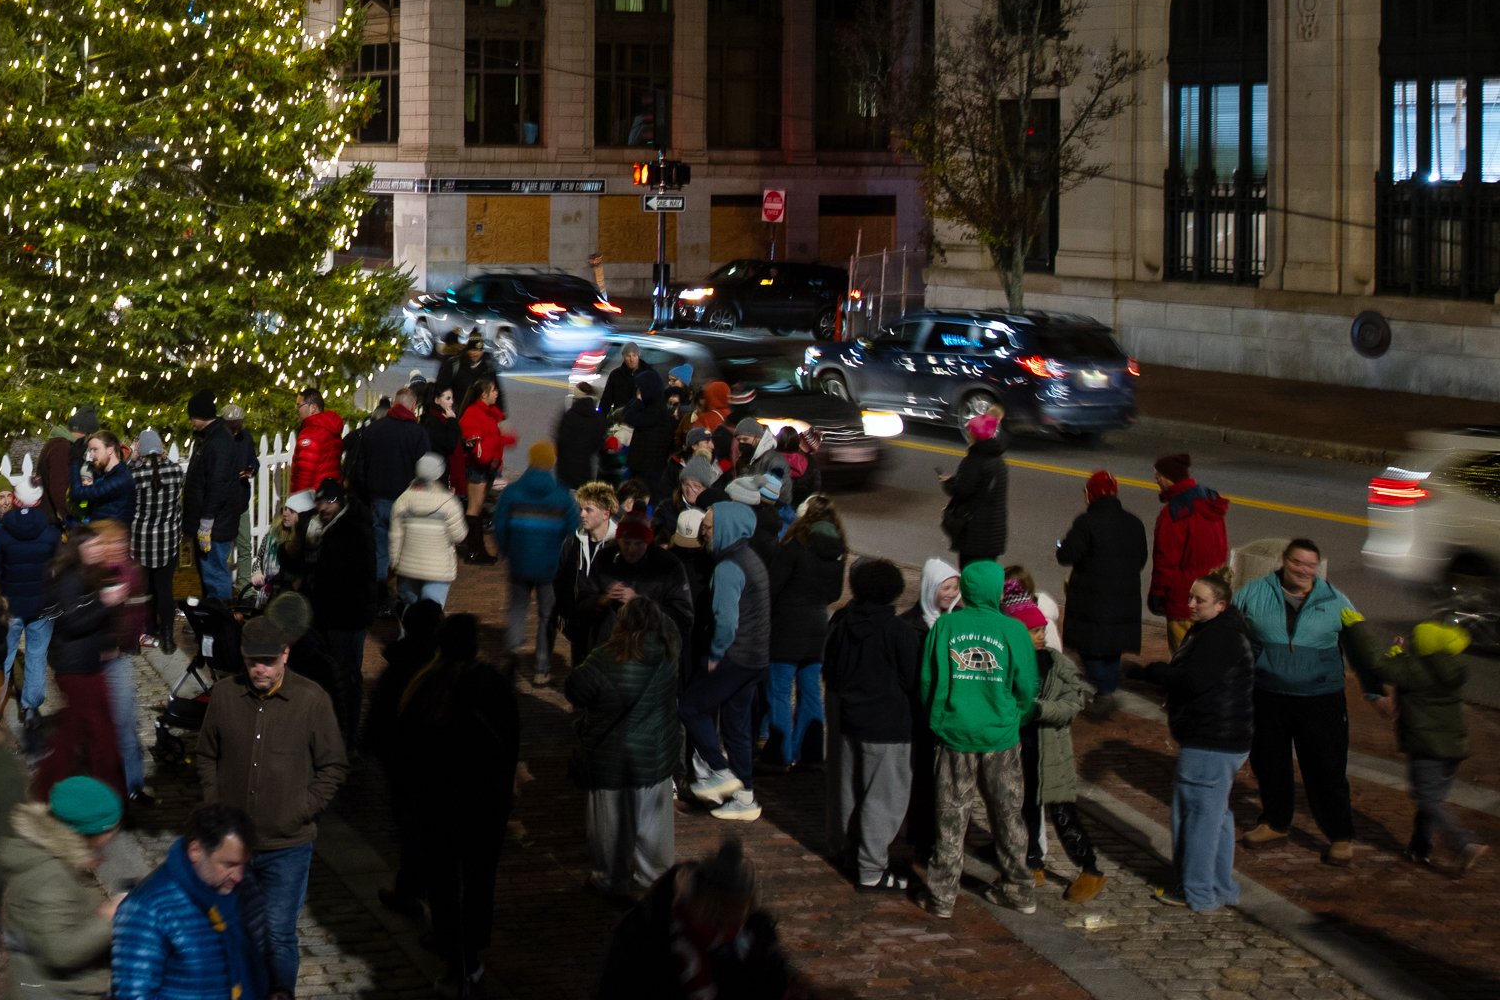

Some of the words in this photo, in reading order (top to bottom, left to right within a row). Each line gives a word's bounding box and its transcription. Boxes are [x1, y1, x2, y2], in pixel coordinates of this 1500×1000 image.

[539, 181, 555, 191] WOLF
[560, 181, 575, 191] NEW
[575, 181, 603, 191] COUNTRY
